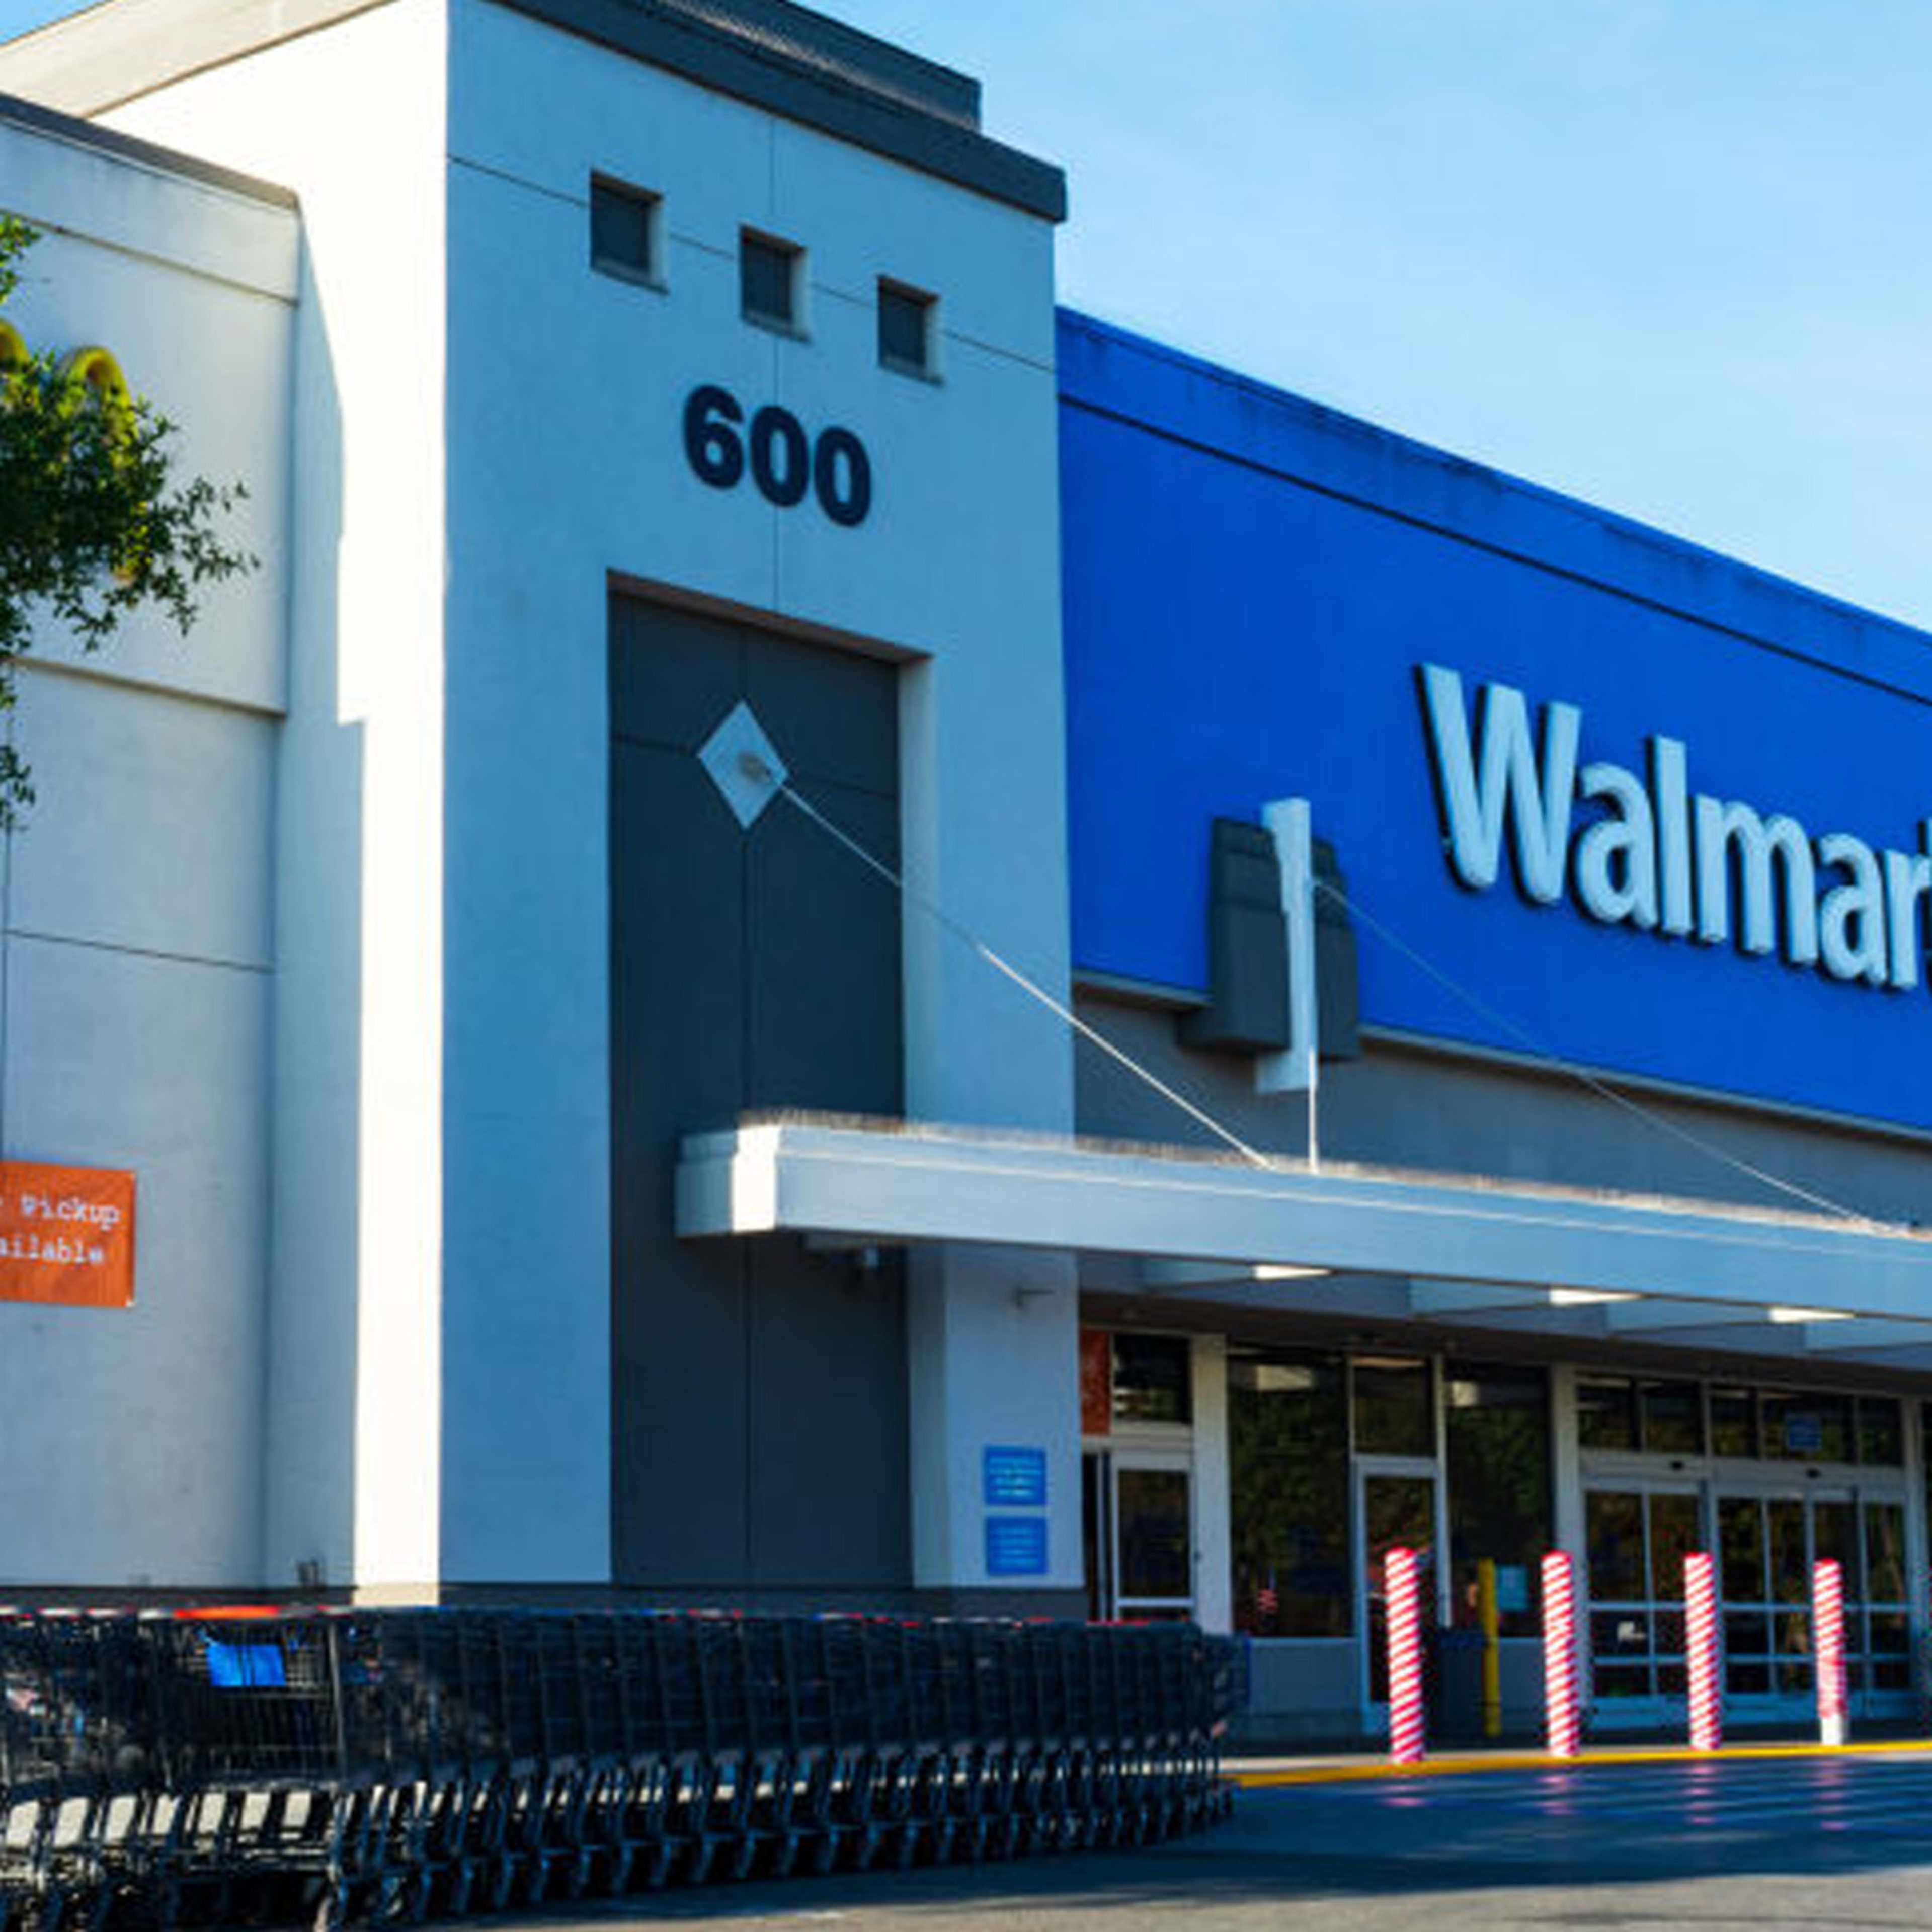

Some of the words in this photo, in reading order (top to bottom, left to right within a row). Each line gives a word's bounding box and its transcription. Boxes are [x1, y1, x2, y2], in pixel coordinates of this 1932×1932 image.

[683, 384, 871, 527] 600
[1416, 661, 1932, 991] Walmar
[21, 1194, 120, 1232] Pickup
